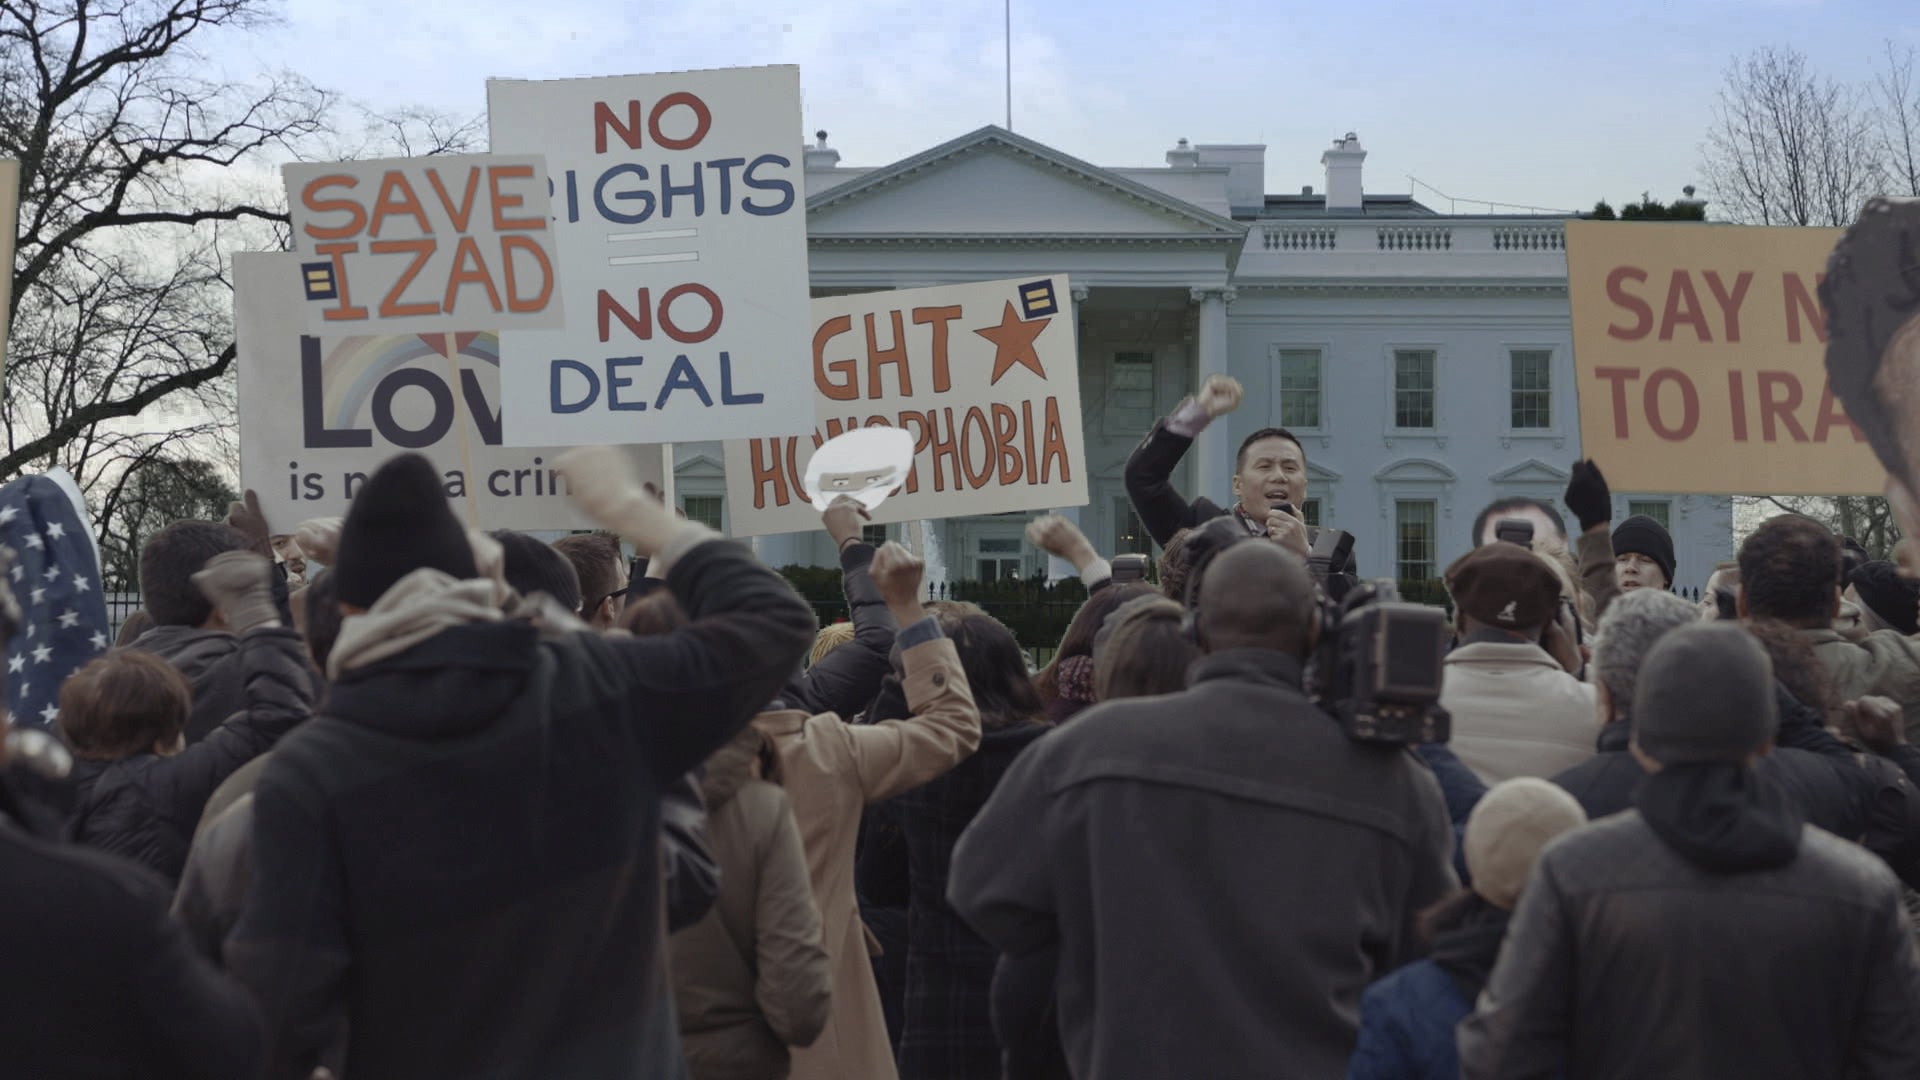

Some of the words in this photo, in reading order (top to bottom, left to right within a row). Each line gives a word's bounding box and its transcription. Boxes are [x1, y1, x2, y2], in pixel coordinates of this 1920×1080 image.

[594, 92, 712, 154] NO
[302, 165, 548, 240] SAVE
[548, 153, 796, 225] IGHTS
[315, 235, 555, 321] IZAD
[597, 282, 724, 344] NO
[1605, 265, 1754, 343] SAY
[550, 351, 765, 414] DEAL
[1594, 366, 1701, 443] TO
[289, 461, 325, 500] is
[444, 470, 467, 498] a
[750, 396, 1071, 509] HOPHOBIA
